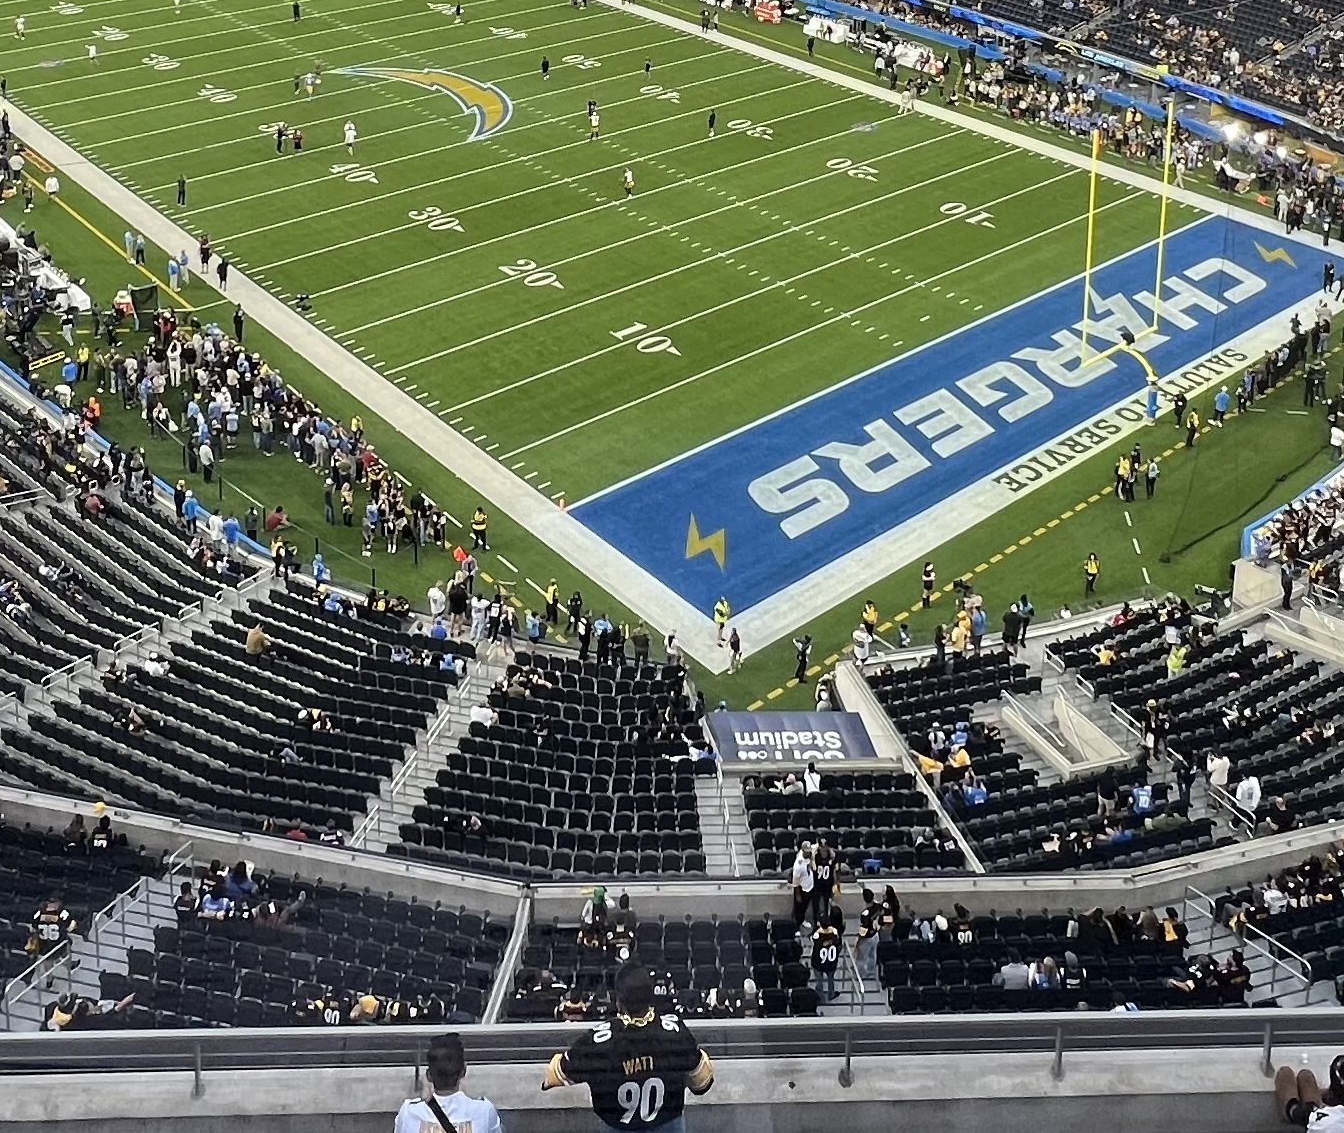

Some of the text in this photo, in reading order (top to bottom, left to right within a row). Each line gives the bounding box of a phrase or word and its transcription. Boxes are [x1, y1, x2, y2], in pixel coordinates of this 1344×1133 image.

[726, 119, 774, 138] 30
[329, 163, 376, 183] 40
[826, 157, 880, 180] 20
[409, 206, 460, 231] 30
[939, 202, 995, 225] 10
[498, 259, 558, 288] 20
[609, 321, 672, 354] 10
[1156, 348, 1249, 403] SALUTE
[747, 257, 1267, 540] CHARGERS
[992, 418, 1122, 493] SERVICE
[735, 730, 842, 750] Stadium
[817, 865, 830, 880] 90
[957, 930, 973, 944] 90
[819, 945, 837, 964] 90
[617, 1077, 665, 1125] 90
